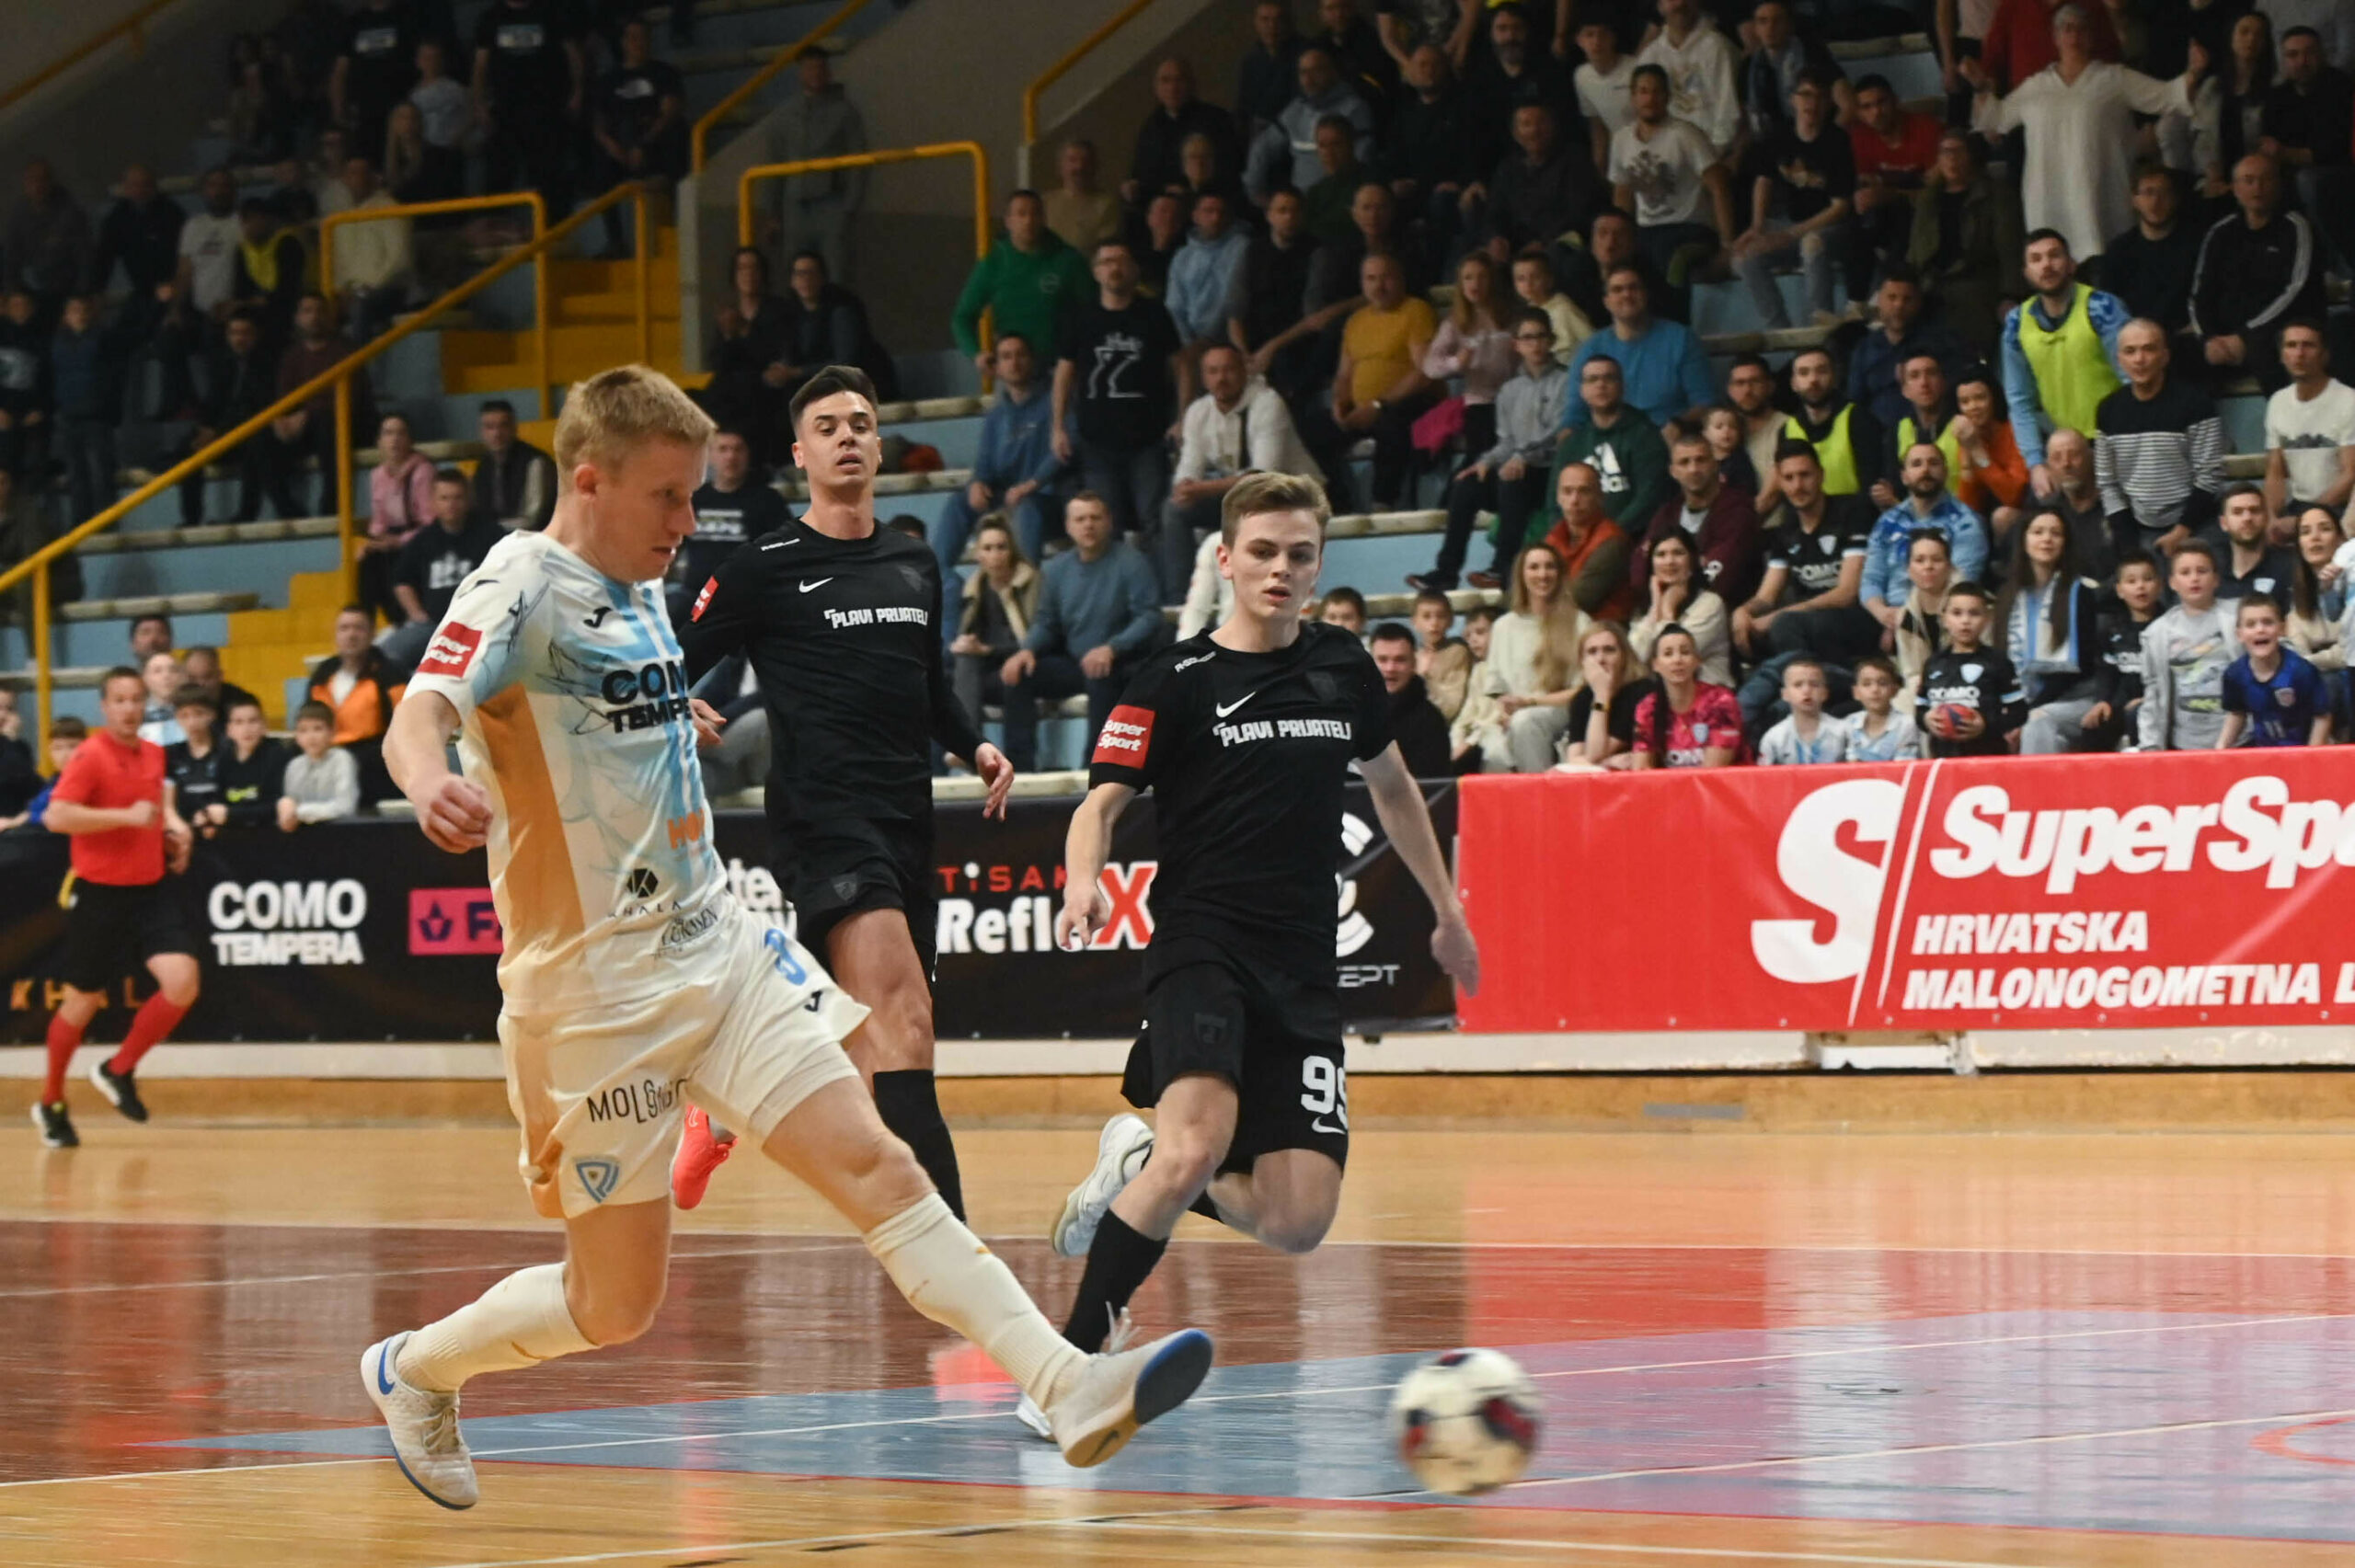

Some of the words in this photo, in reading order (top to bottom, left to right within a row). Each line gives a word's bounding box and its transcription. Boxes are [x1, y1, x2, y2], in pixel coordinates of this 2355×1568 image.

[832, 609, 873, 629] PLAVI
[1098, 734, 1142, 751] Sport
[1220, 721, 1274, 748] PLAVI
[209, 879, 367, 930] COMO
[1912, 911, 2148, 955] HRVATSKA
[211, 932, 364, 966] TEMPERA
[1336, 964, 1401, 988] EPT
[1902, 964, 2321, 1011] MALONOGOMETNA
